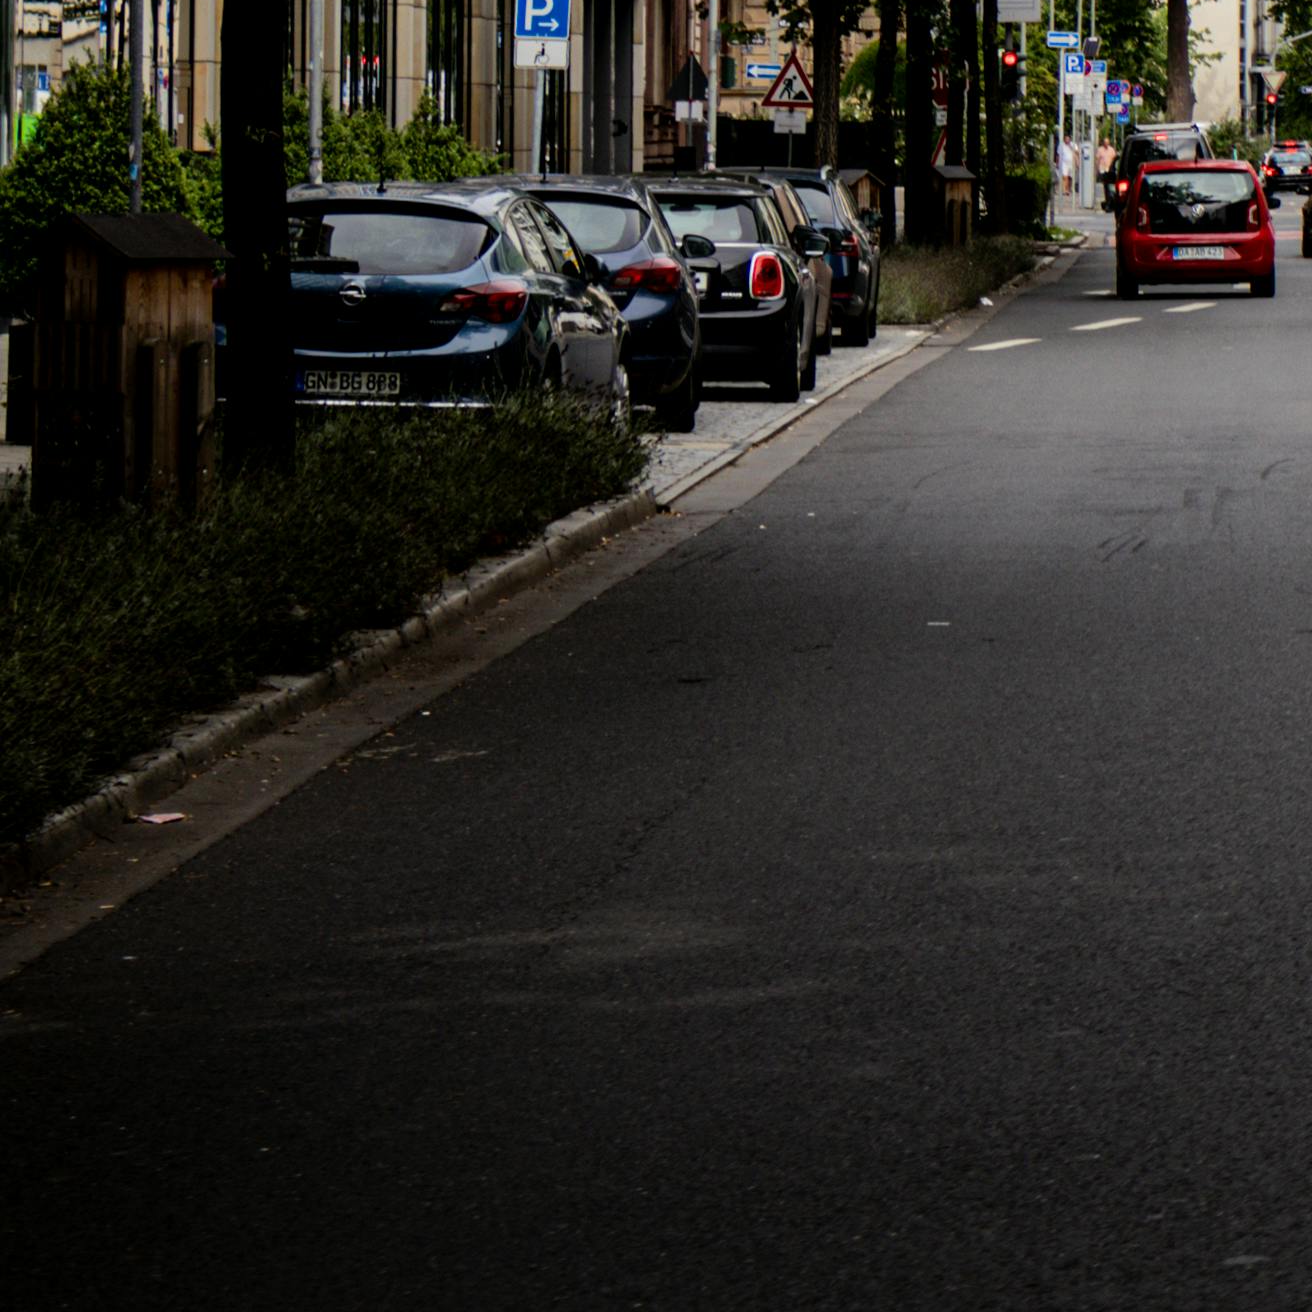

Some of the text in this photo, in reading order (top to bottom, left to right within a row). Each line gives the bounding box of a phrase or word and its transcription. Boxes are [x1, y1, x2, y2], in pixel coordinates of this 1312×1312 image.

[1068, 56, 1079, 72] P
[305, 372, 328, 389] GN
[339, 372, 362, 390] BG
